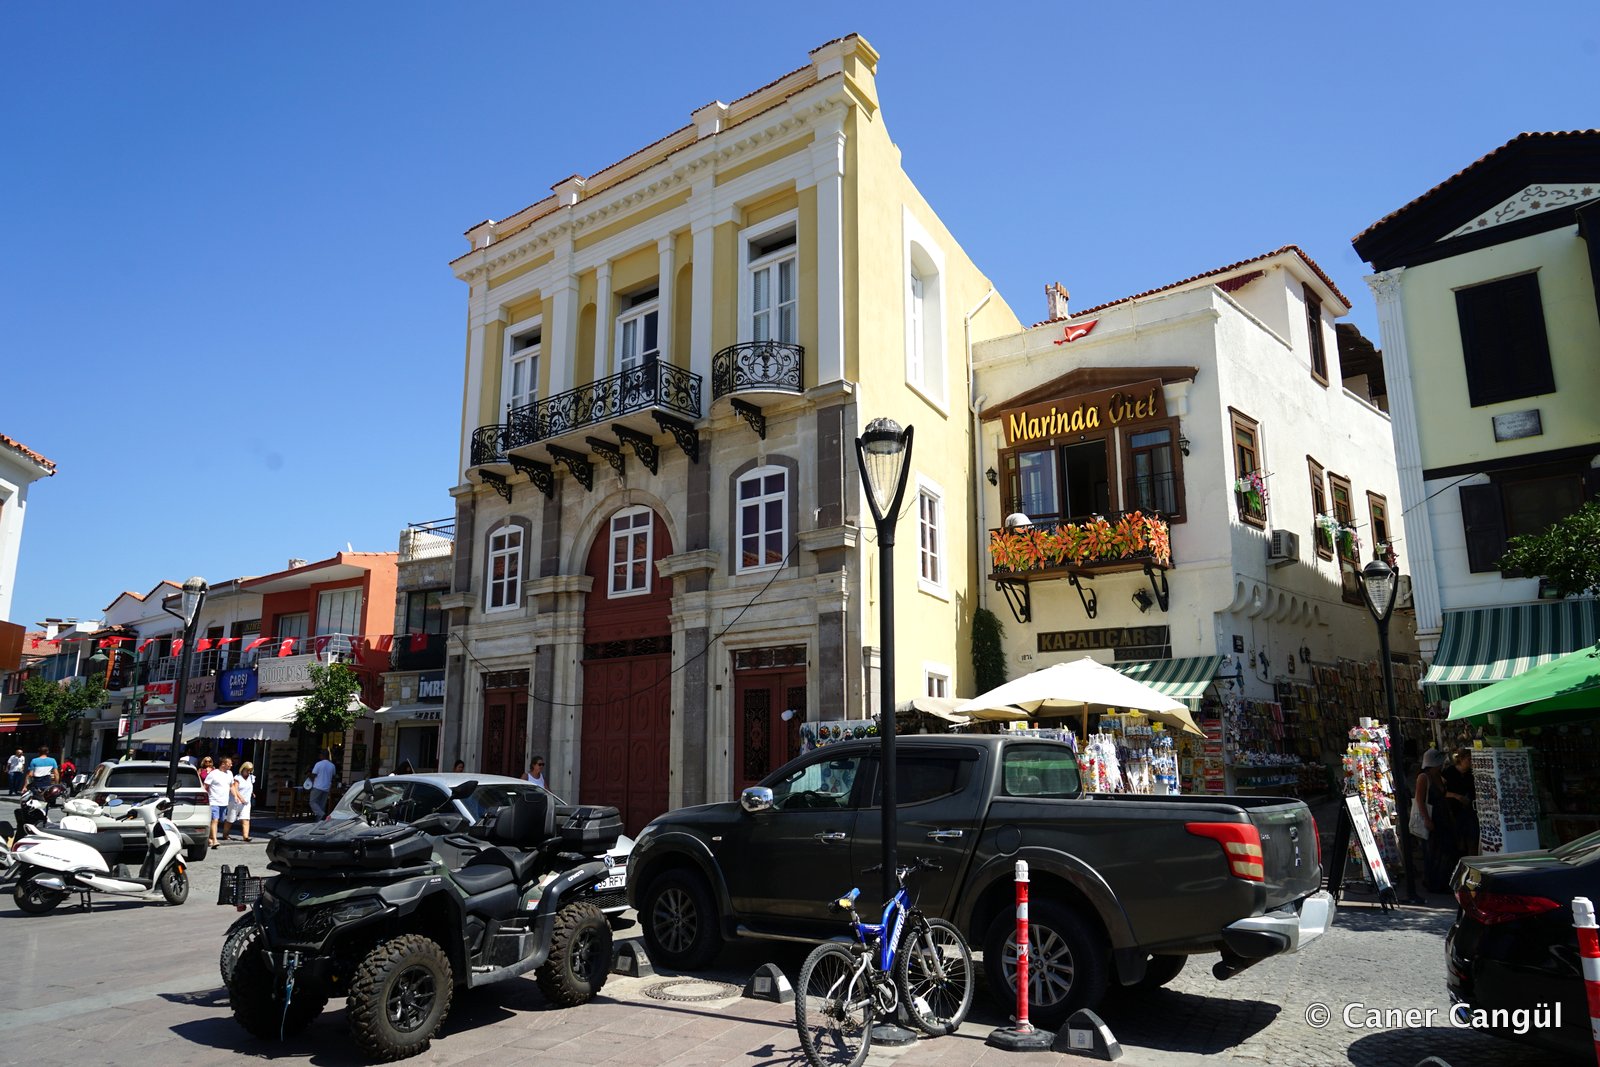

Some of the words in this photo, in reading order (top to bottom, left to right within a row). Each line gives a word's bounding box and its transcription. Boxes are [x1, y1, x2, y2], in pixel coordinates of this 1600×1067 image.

[1010, 402, 1100, 442] Marinda
[1108, 387, 1157, 424] Otel
[1118, 650, 1144, 659] 200
[609, 876, 624, 887] RFY
